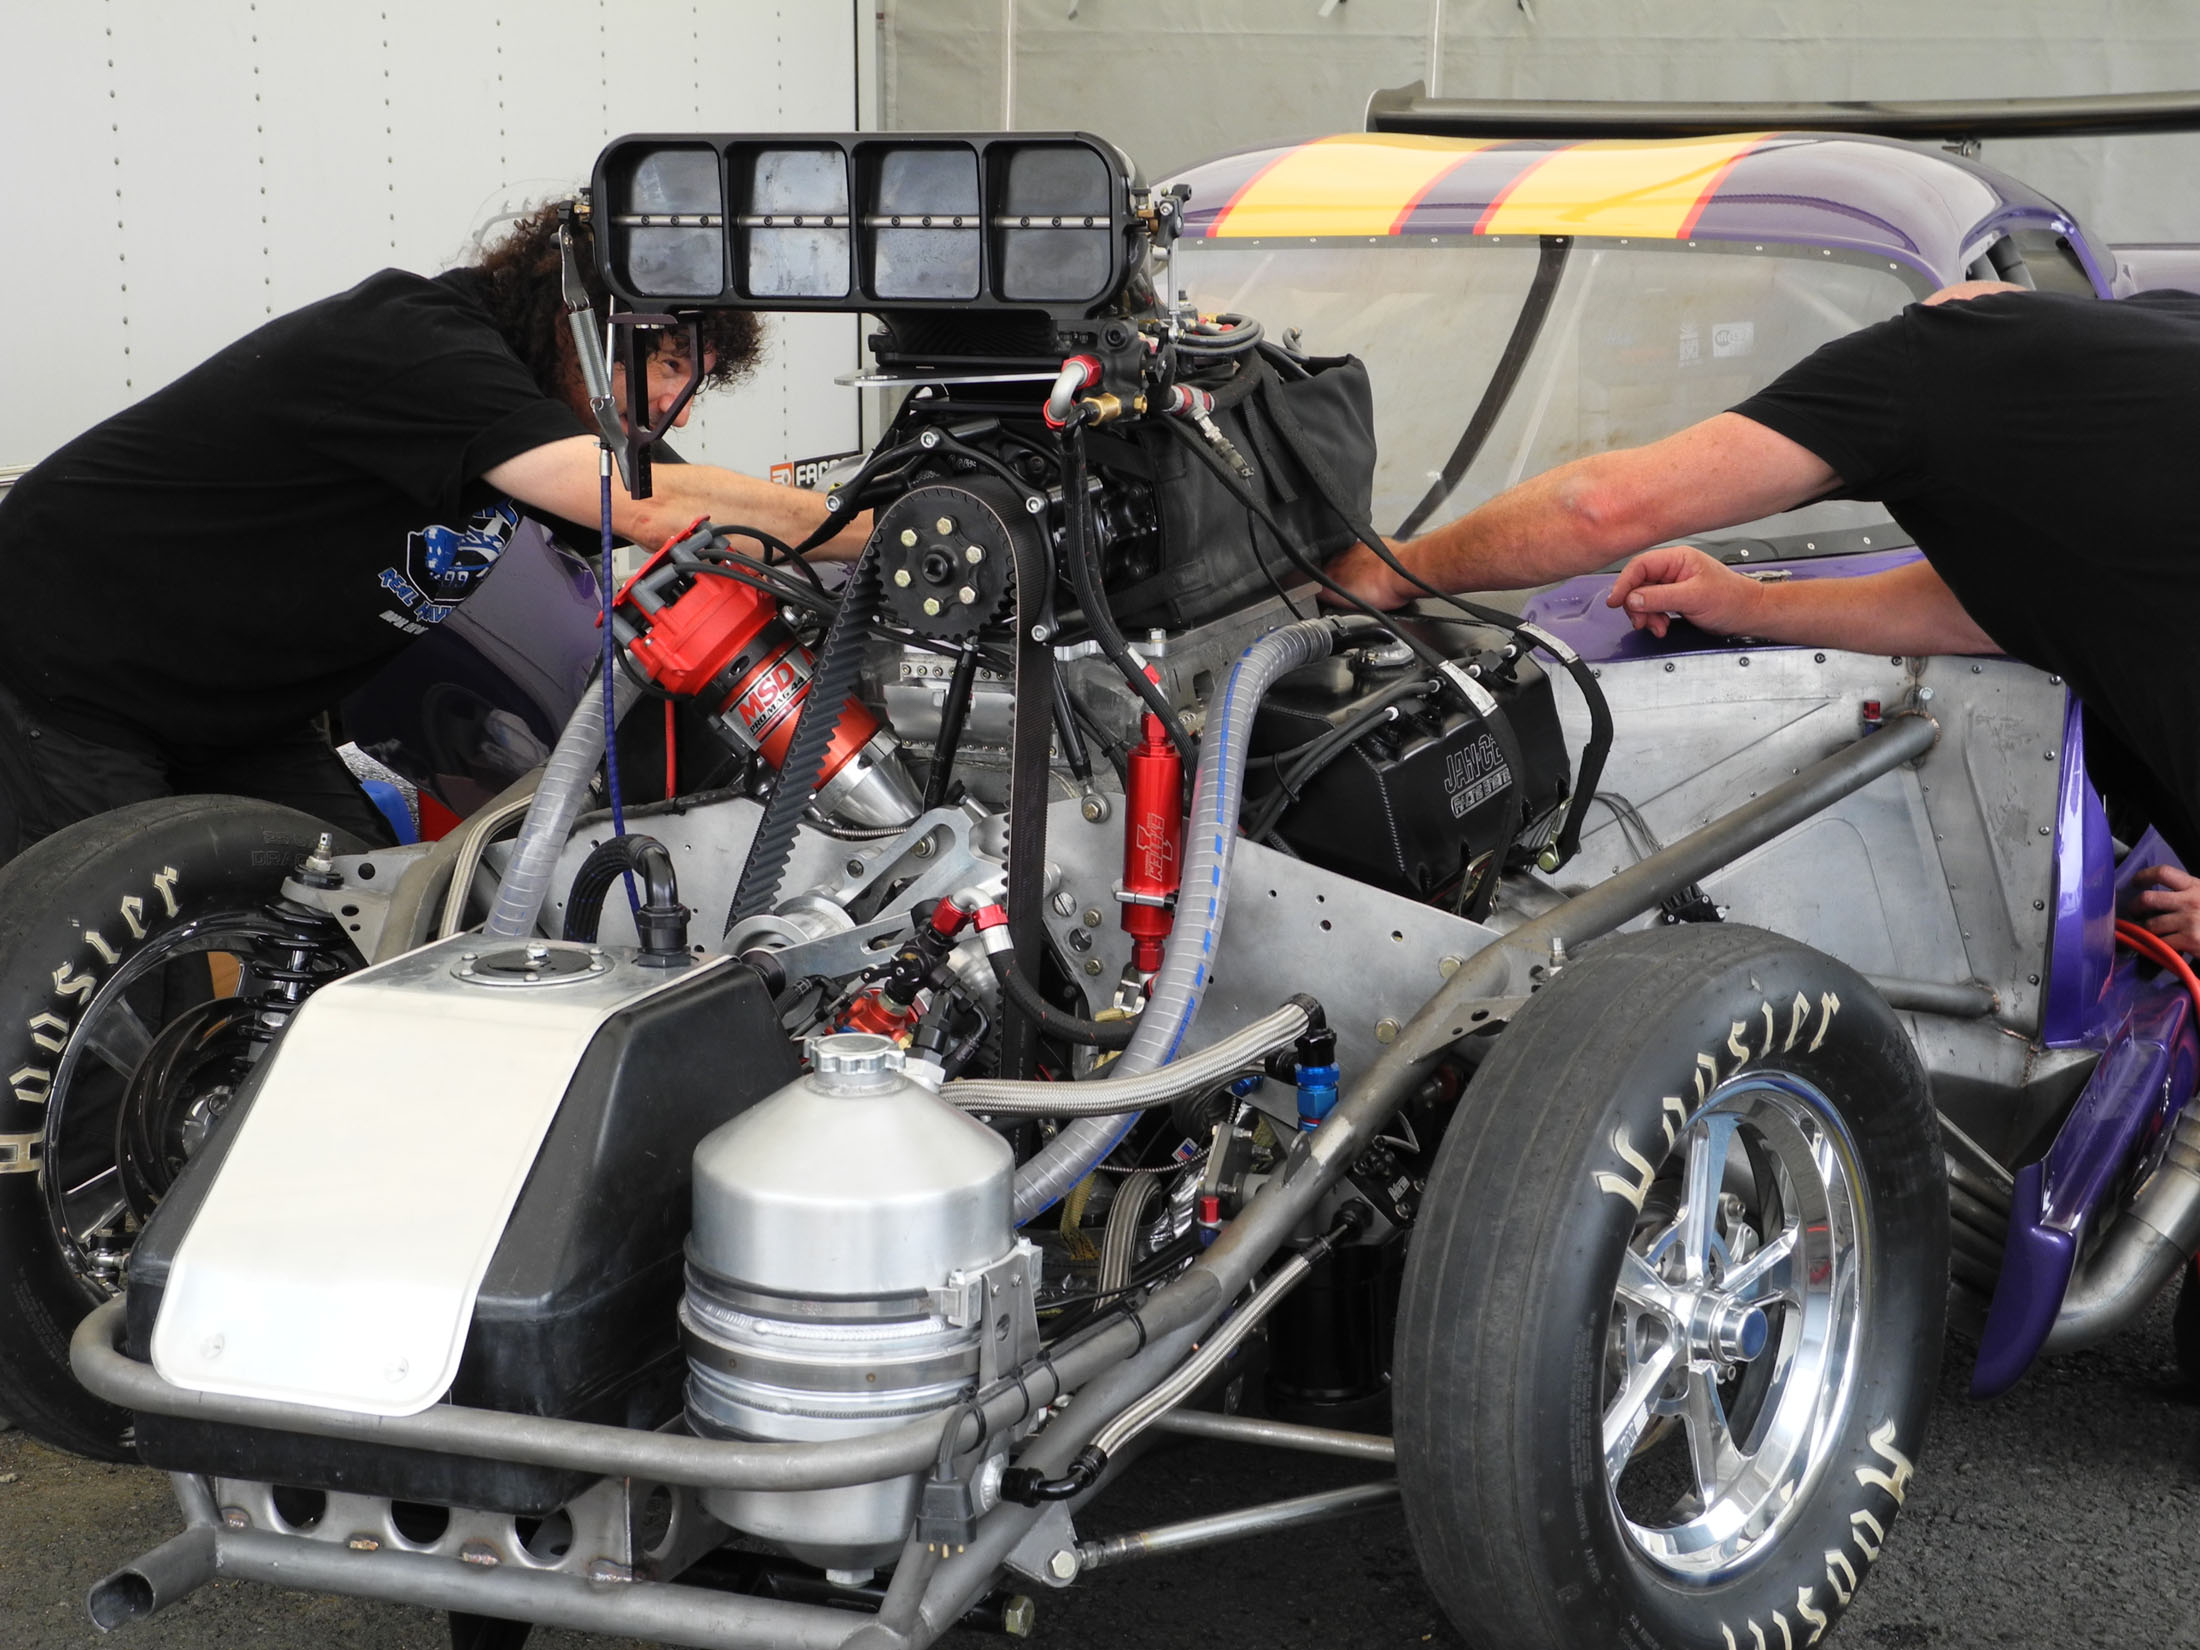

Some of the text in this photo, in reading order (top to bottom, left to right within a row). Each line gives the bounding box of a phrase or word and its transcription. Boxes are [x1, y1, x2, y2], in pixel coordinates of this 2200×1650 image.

[796, 458, 847, 487] FAC
[378, 567, 419, 607] REAL
[738, 662, 796, 727] MSD
[749, 676, 805, 733] PRO MAG 44
